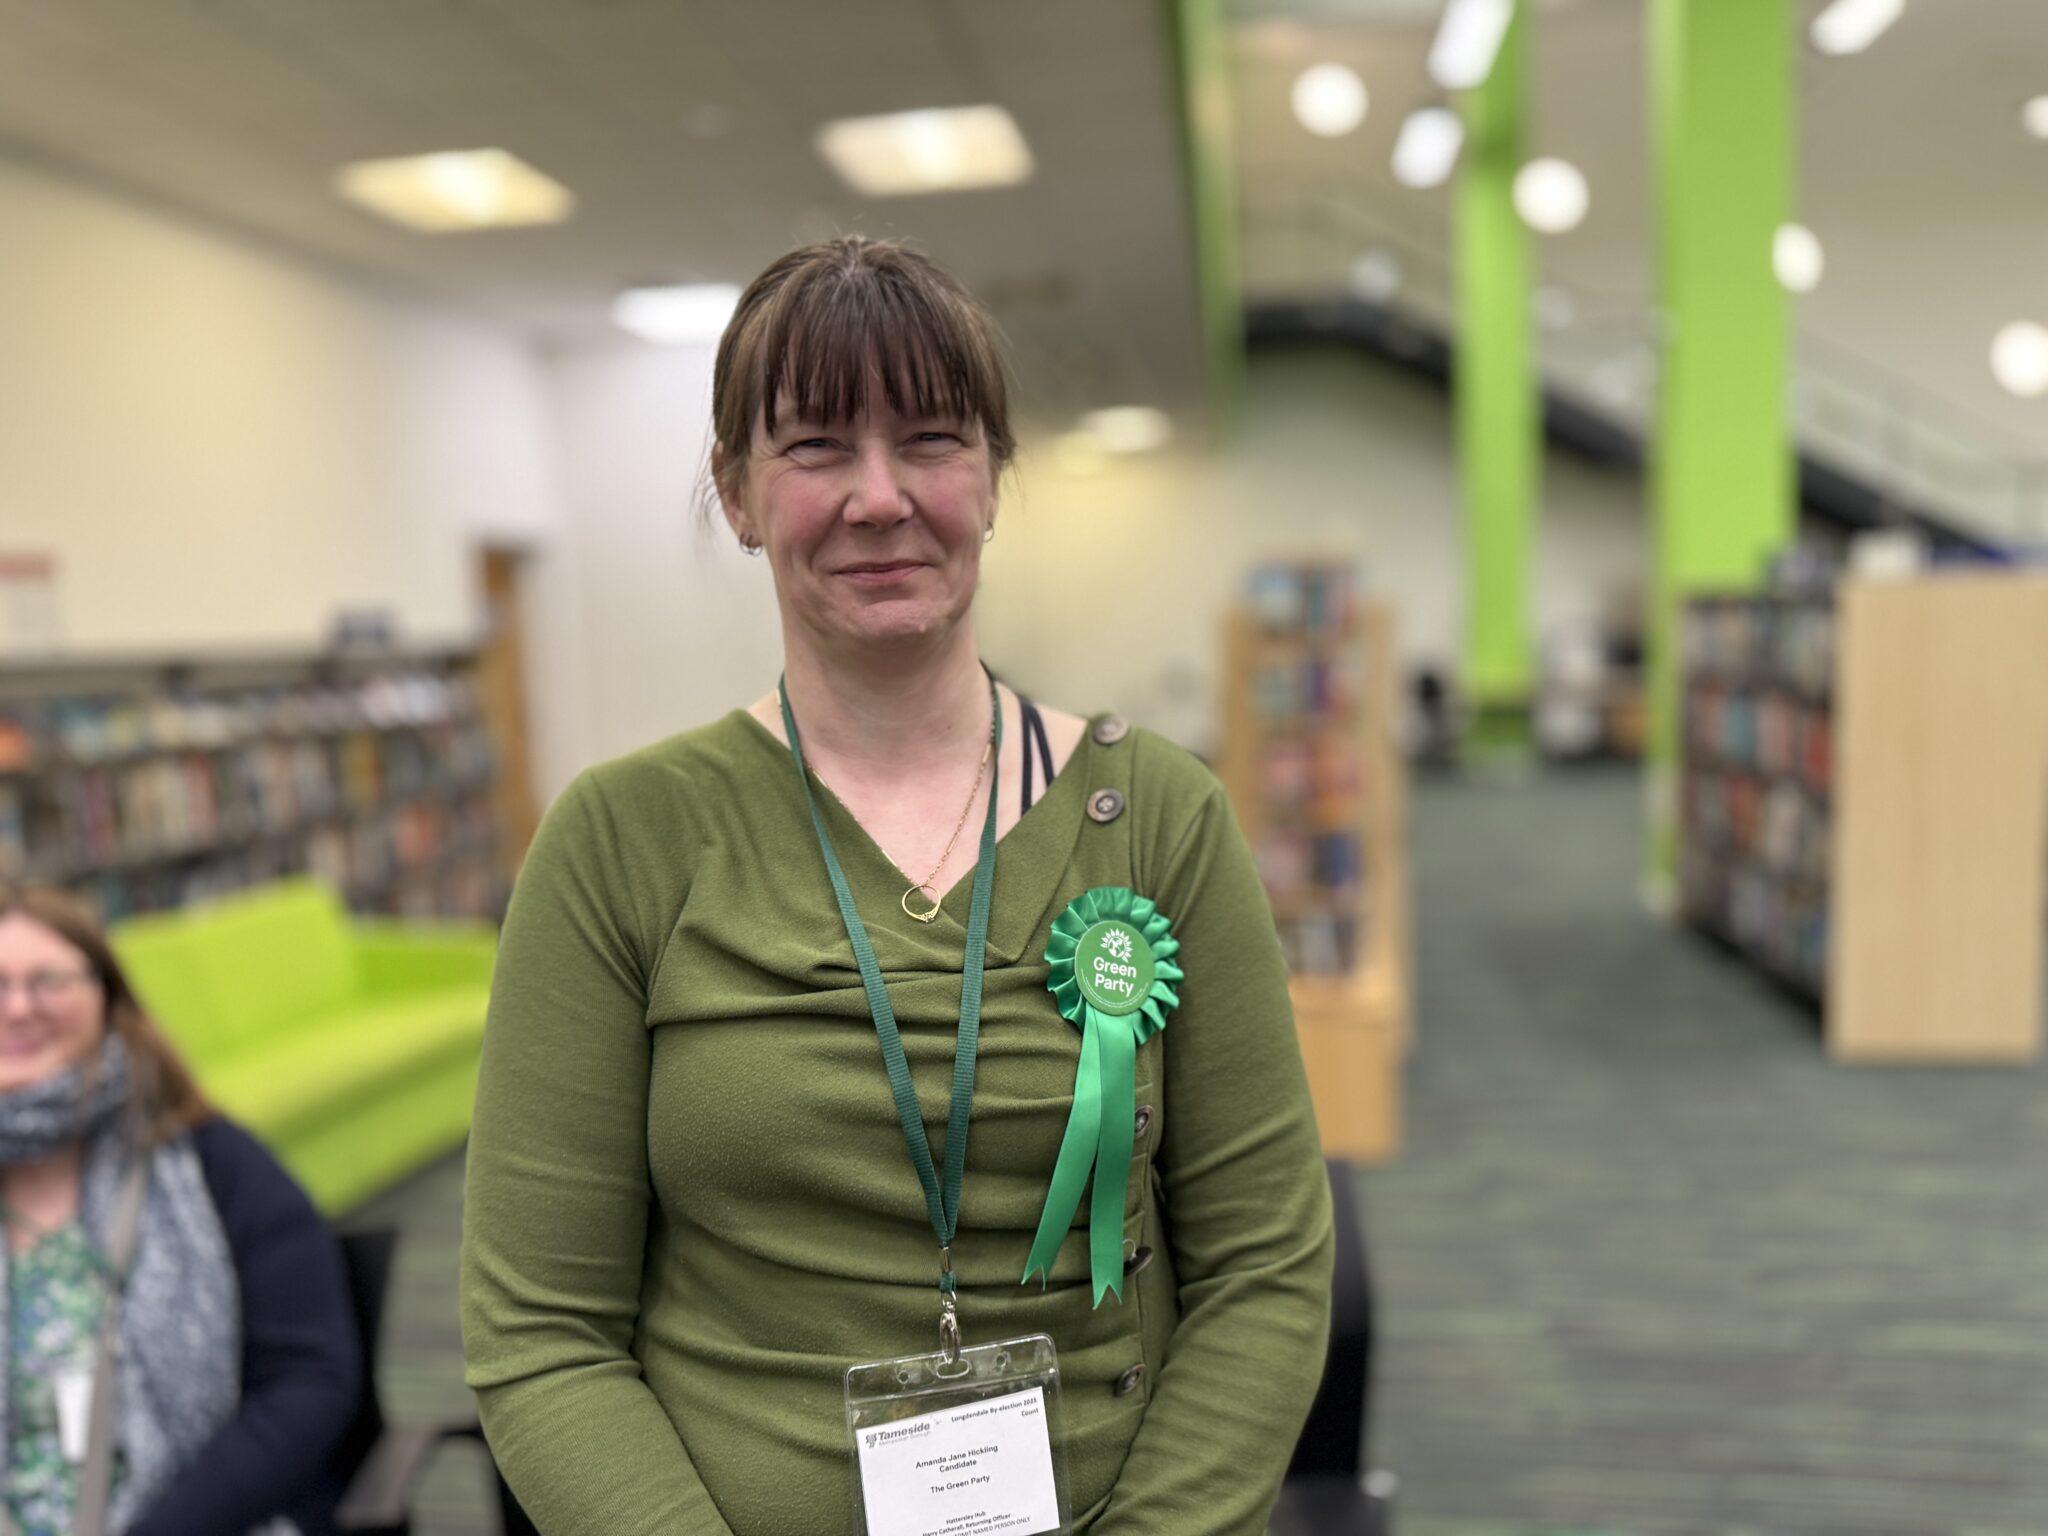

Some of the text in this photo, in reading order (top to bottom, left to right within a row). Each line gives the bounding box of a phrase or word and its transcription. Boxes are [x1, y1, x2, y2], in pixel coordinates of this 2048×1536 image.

[1093, 956, 1137, 978] Green
[1094, 973, 1134, 998] Party
[951, 1409, 989, 1422] Longdendale
[1021, 1408, 1039, 1417] Count
[878, 1422, 931, 1441] Tameside
[915, 1445, 999, 1469] Amanda Jane Hickling
[939, 1459, 977, 1473] Candidate
[930, 1475, 990, 1494] The Green Party
[994, 1520, 1016, 1531] PERSON
